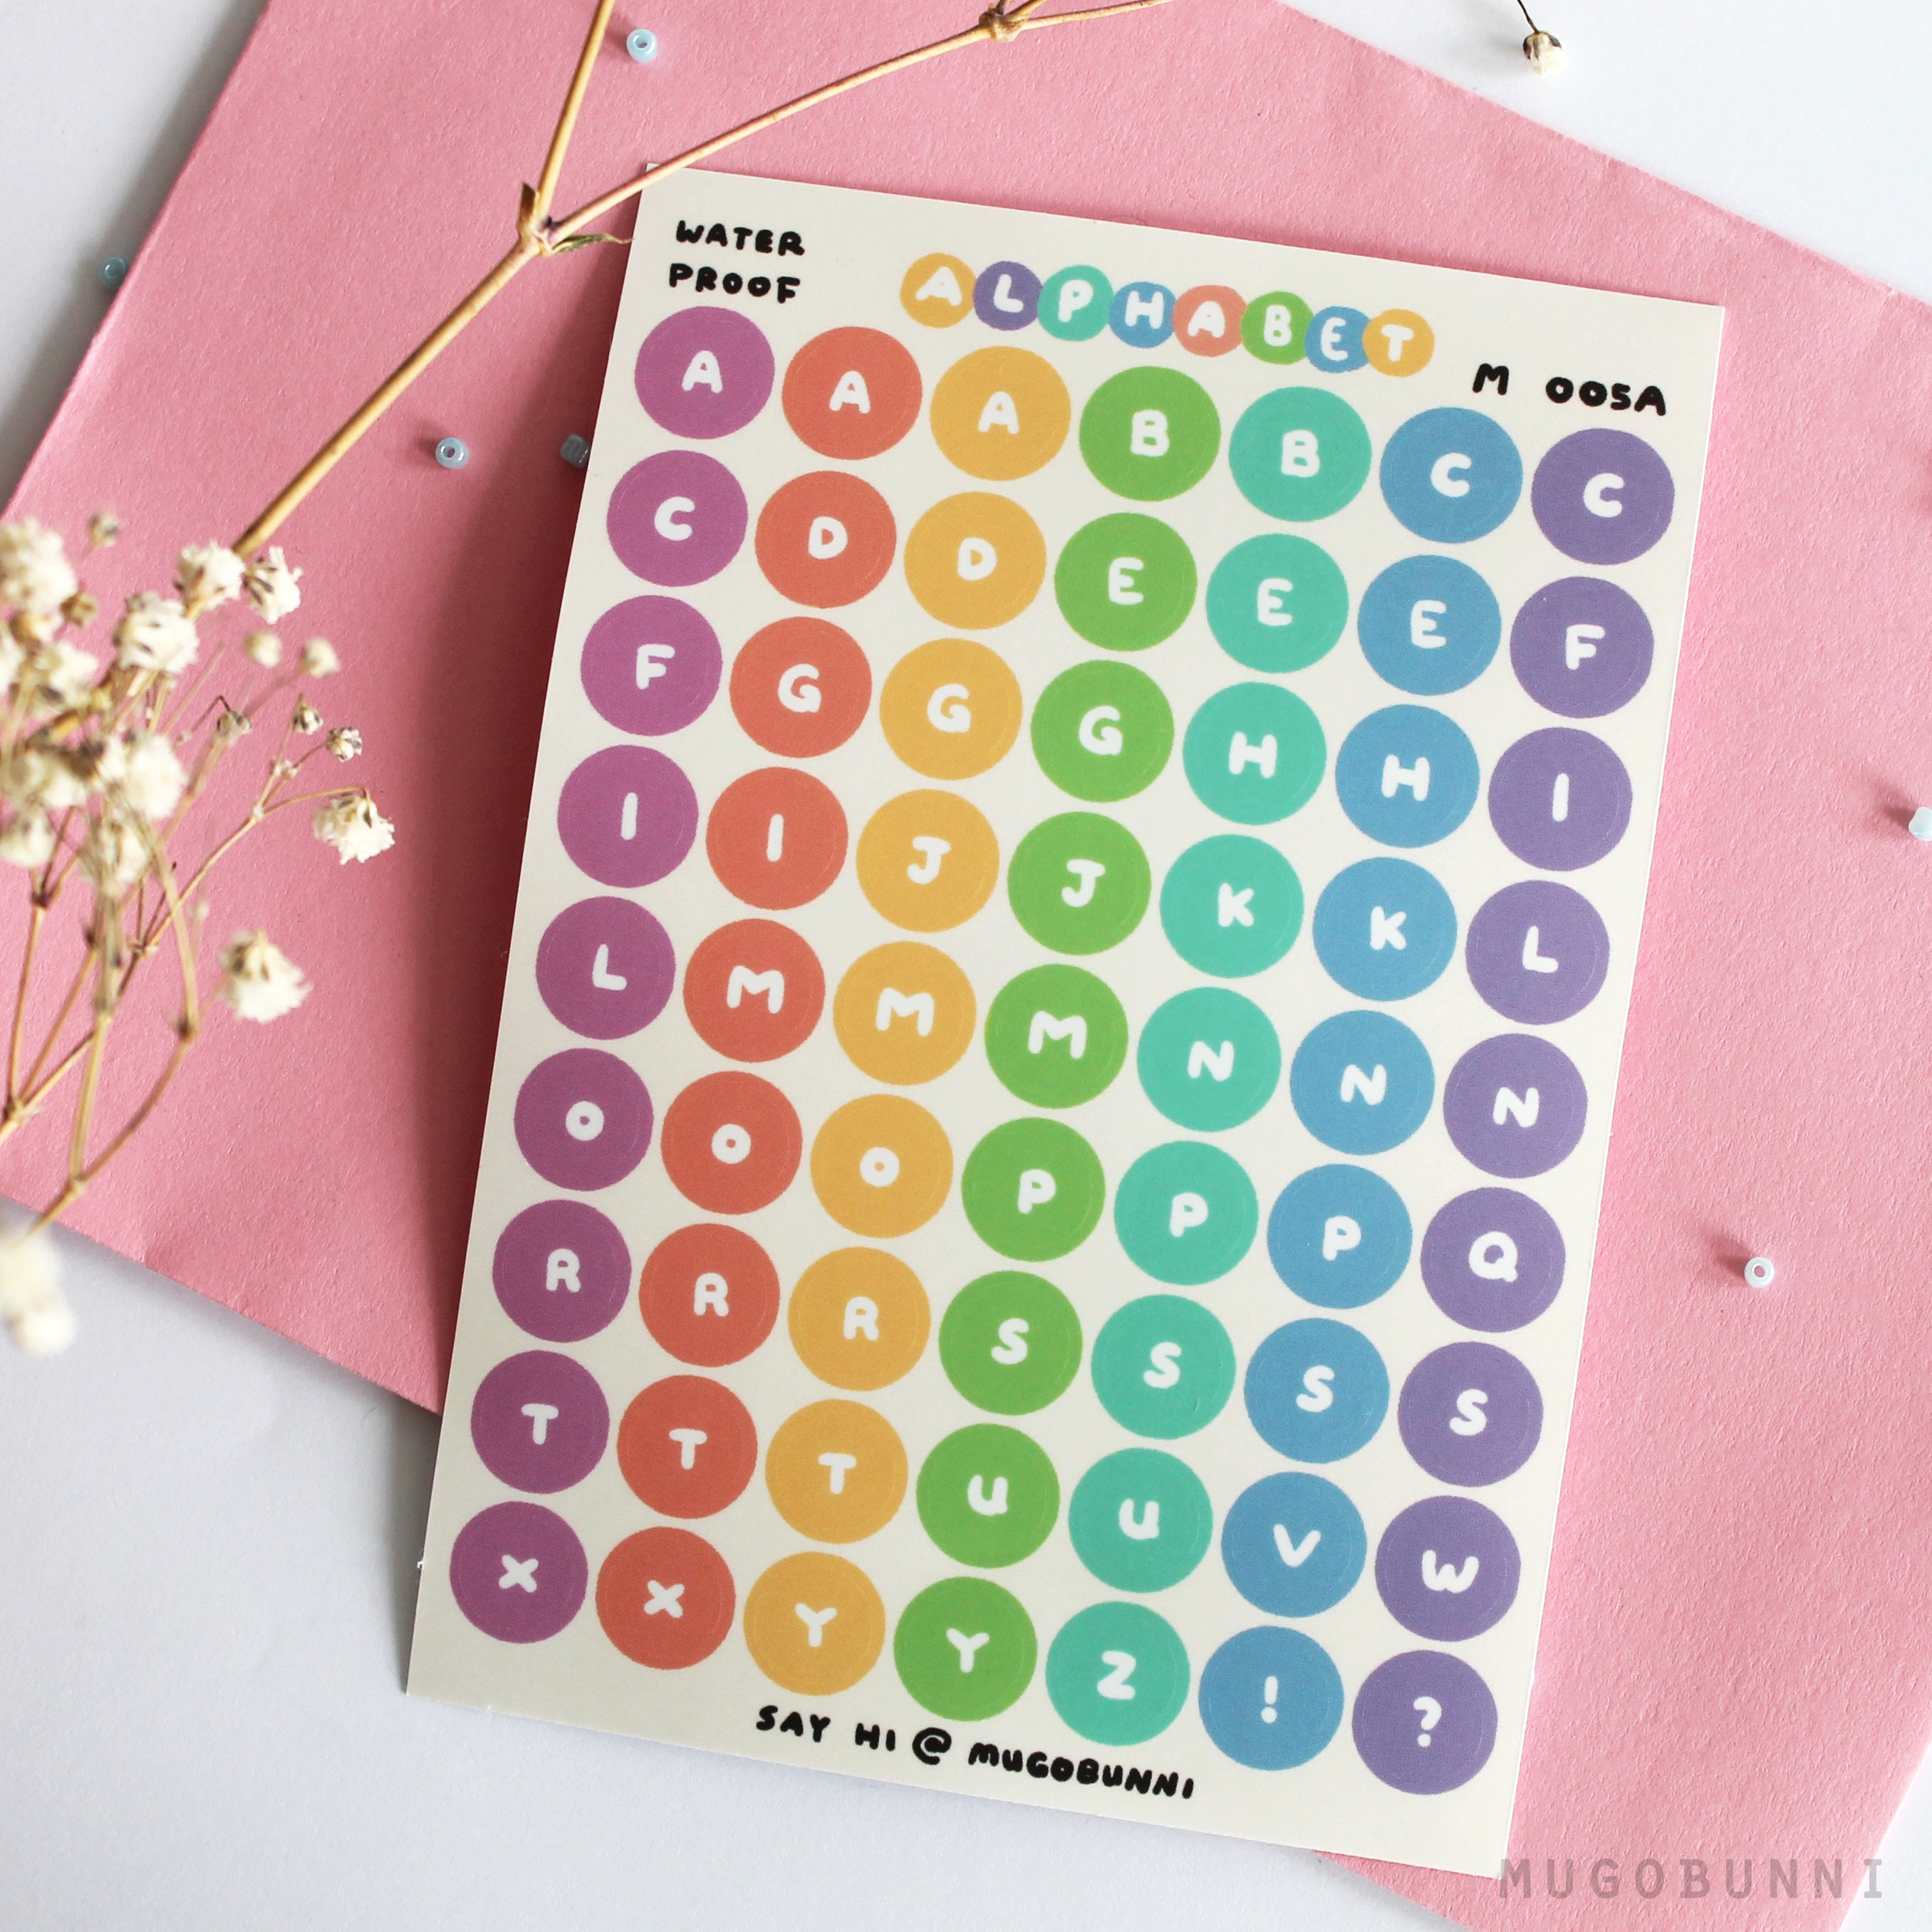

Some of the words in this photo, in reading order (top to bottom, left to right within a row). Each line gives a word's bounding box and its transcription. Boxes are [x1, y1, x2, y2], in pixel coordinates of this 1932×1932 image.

[669, 263, 801, 304] PROOF
[675, 220, 805, 256] WATER
[915, 266, 1414, 362] ALPHABET
[681, 350, 723, 394] A
[829, 370, 871, 414] A
[977, 390, 1020, 435] A
[1130, 409, 1170, 457] B
[1280, 429, 1321, 478] B
[1430, 452, 1472, 498] C
[1582, 472, 1625, 518] C
[1472, 363, 1510, 395] M
[653, 496, 695, 541] C
[808, 516, 848, 560] D
[957, 536, 998, 581] D
[1108, 556, 1144, 606] E
[1257, 577, 1294, 627] E
[1410, 599, 1447, 649] E
[1565, 623, 1606, 670] F
[635, 643, 675, 690] F
[777, 663, 822, 713] G
[926, 682, 972, 734] G
[1078, 705, 1123, 756] G
[1228, 732, 1278, 779] H
[1381, 754, 1431, 801] H
[1552, 772, 1570, 822] I
[620, 792, 638, 841] I
[766, 814, 784, 863] I
[907, 836, 952, 885] J
[1061, 858, 1106, 908] J
[1217, 882, 1255, 928] K
[1369, 905, 1407, 950] K
[1522, 925, 1559, 974] L
[591, 943, 628, 991] L
[726, 965, 785, 1014] M
[875, 987, 935, 1037] M
[1027, 1010, 1088, 1059] M
[1187, 1040, 1235, 1082] N
[1339, 1064, 1387, 1106] N
[1492, 1086, 1540, 1128] N
[565, 1100, 605, 1141] O
[711, 1123, 752, 1165] O
[859, 1146, 900, 1188] O
[1017, 1168, 1056, 1215] P
[1169, 1192, 1209, 1237] P
[1321, 1215, 1362, 1261] P
[1468, 1230, 1519, 1283] Q
[545, 1247, 581, 1293] R
[693, 1272, 729, 1317] R
[843, 1296, 880, 1341] R
[991, 1317, 1029, 1365] S
[1143, 1341, 1182, 1389] S
[1296, 1365, 1335, 1413] S
[1449, 1388, 1488, 1436] S
[521, 1403, 559, 1445] T
[668, 1428, 708, 1470] T
[818, 1452, 857, 1495] T
[967, 1475, 1009, 1517] U
[1118, 1498, 1160, 1540] U
[1273, 1524, 1321, 1567] V
[1421, 1549, 1480, 1594] W
[498, 1554, 539, 1593] X
[643, 1579, 685, 1619] X
[794, 1602, 838, 1648] Y
[946, 1628, 990, 1673] Y
[1096, 1650, 1137, 1700] Z
[1260, 1676, 1279, 1724] !
[1413, 1695, 1443, 1747] ?
[756, 1705, 831, 1743] SAY
[855, 1723, 896, 1752] HI
[967, 1742, 1194, 1799] MUGOBUNNI
